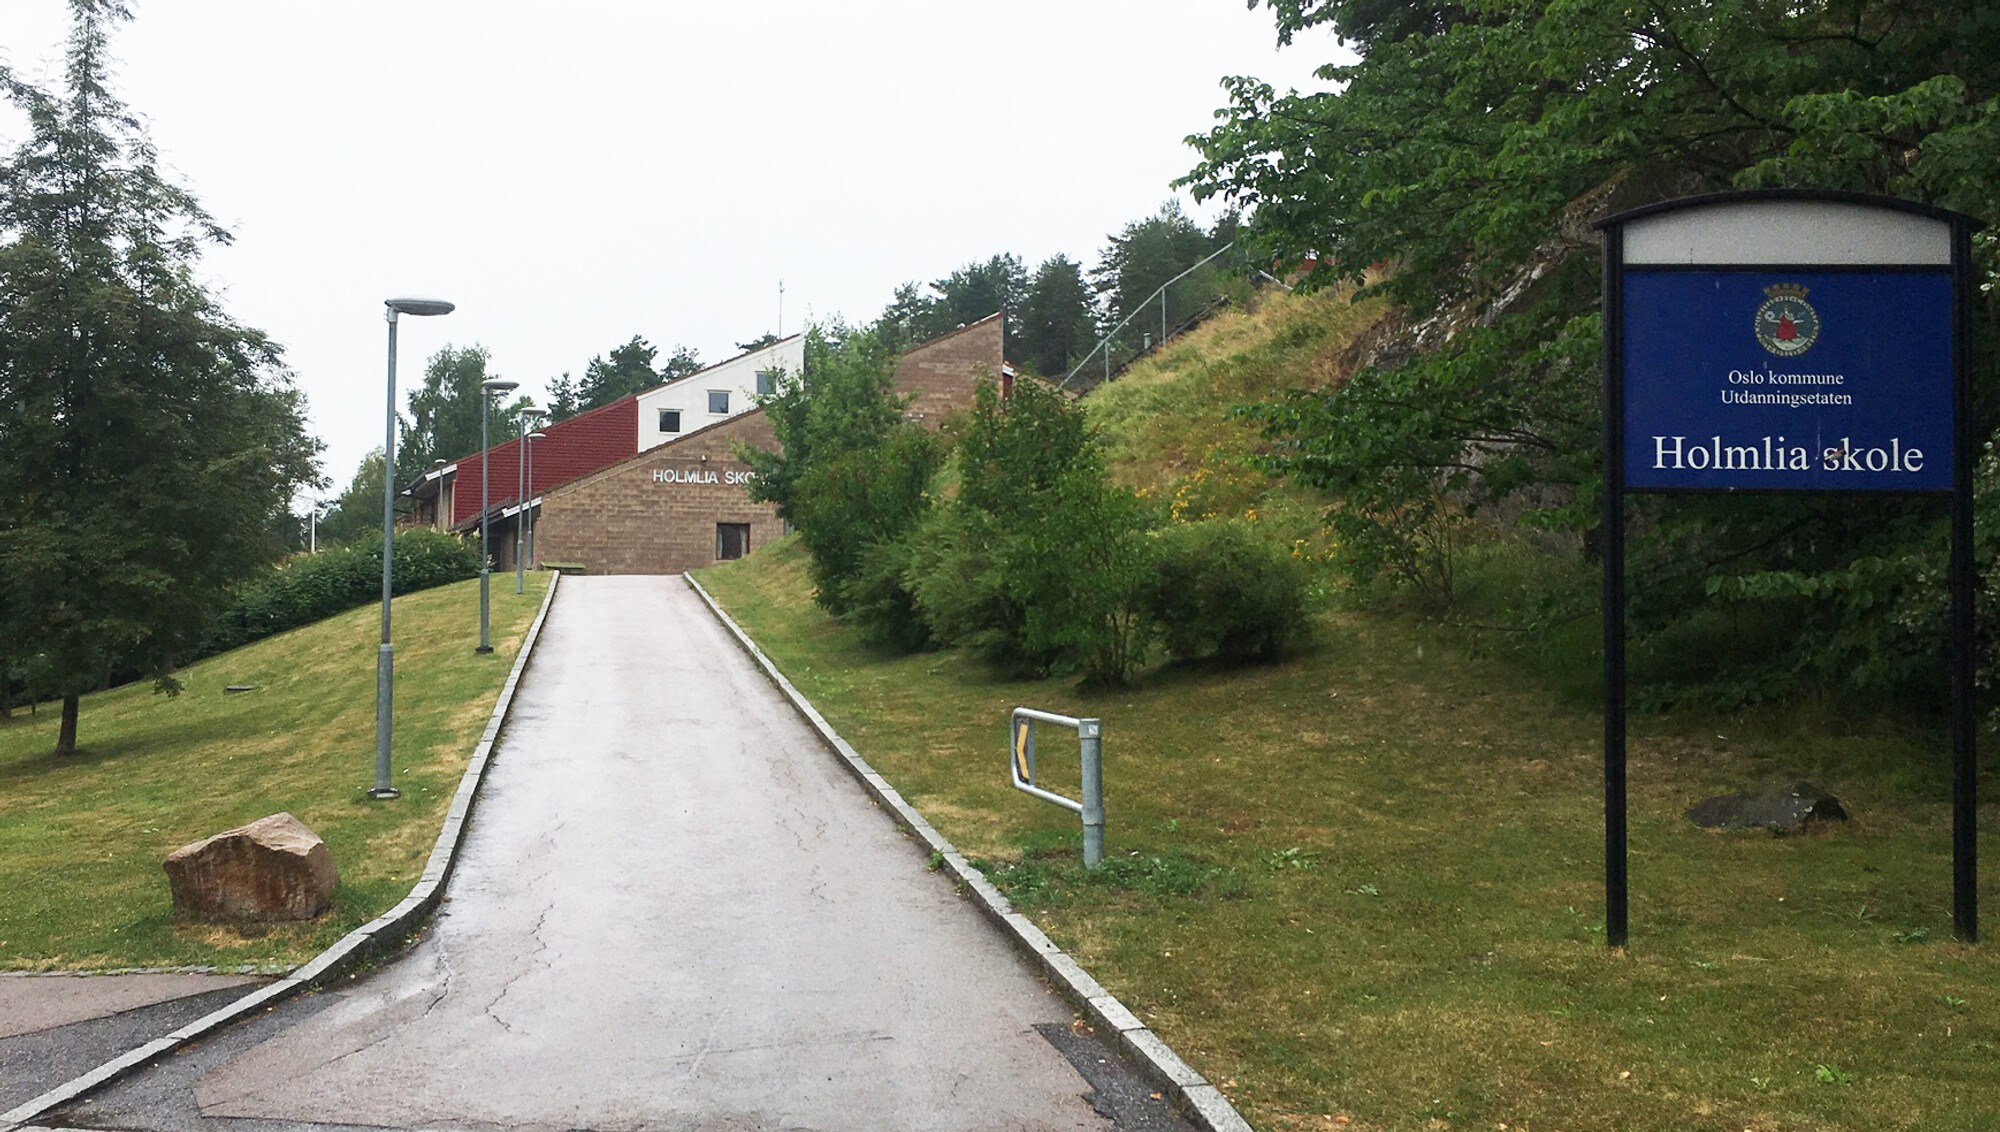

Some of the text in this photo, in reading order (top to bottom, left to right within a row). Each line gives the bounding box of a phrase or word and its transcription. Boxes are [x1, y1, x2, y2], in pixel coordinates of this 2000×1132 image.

[1728, 370, 1844, 385] Oslo kommune
[1721, 389, 1853, 407] Utdanningsetaten
[1652, 436, 1924, 472] Holmlia skole
[652, 469, 719, 484] HOLMLIA
